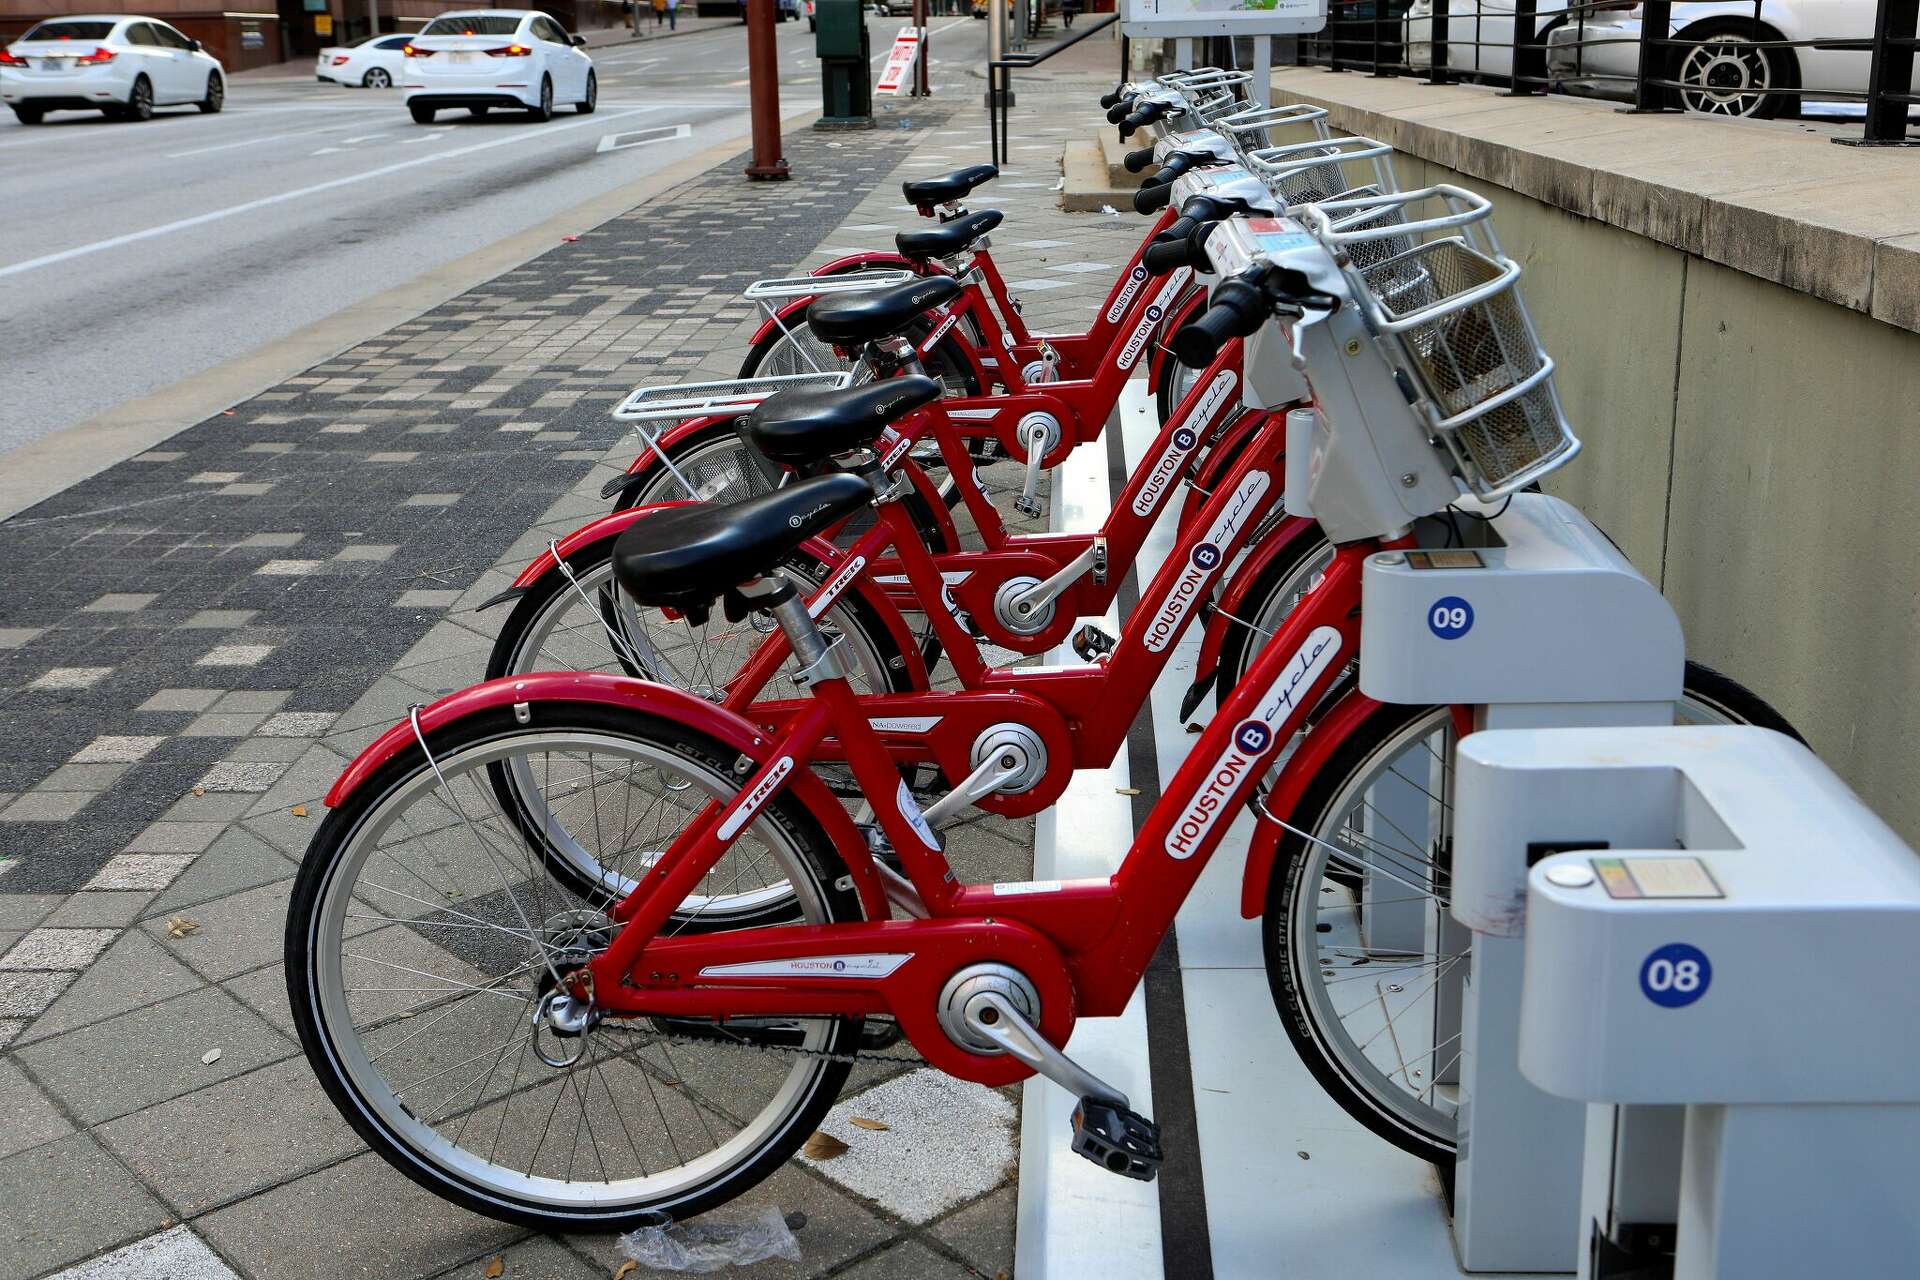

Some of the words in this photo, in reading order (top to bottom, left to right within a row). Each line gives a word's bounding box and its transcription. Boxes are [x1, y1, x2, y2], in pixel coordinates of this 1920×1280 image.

[1109, 279, 1138, 321] HOUSTON
[934, 317, 955, 339] TREK
[1120, 320, 1152, 367] HOUSTON
[882, 442, 906, 469] TREK
[1135, 449, 1183, 513] HOUSTON
[824, 560, 862, 597] TREK
[1147, 569, 1204, 648] HOUSTON
[1433, 606, 1467, 629] 09
[742, 761, 788, 812] TREK
[1170, 753, 1247, 854] HOUSTON
[790, 961, 833, 970] HOUSTON
[1647, 959, 1701, 993] 08
